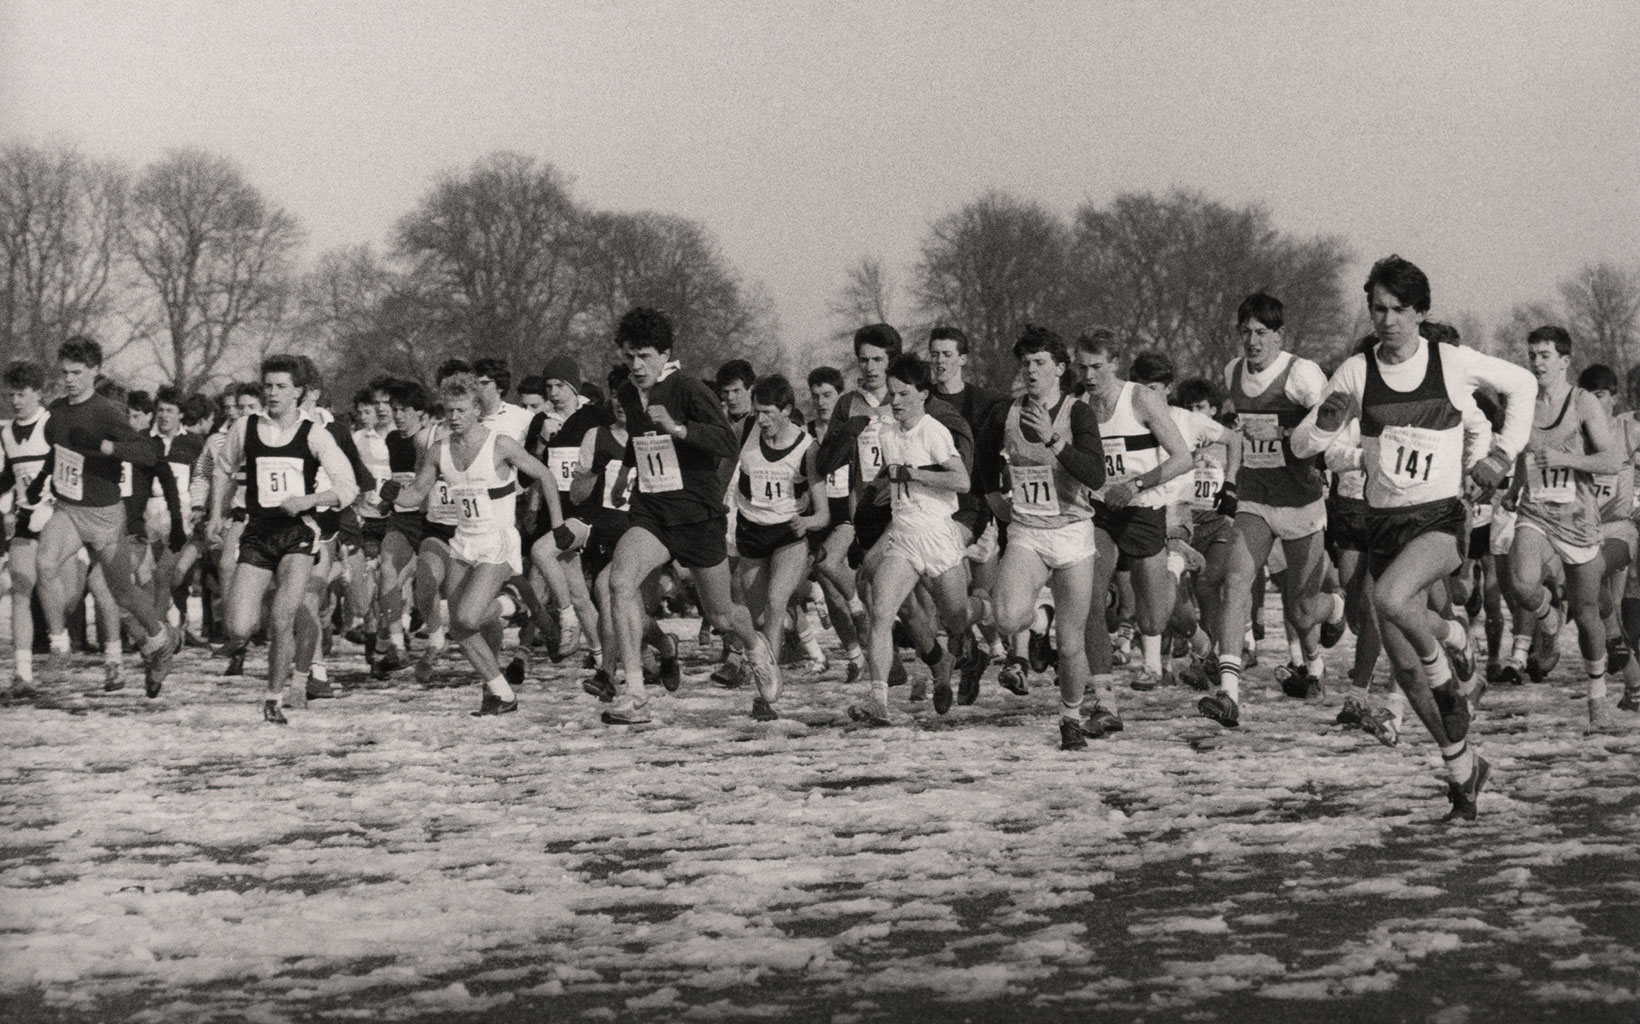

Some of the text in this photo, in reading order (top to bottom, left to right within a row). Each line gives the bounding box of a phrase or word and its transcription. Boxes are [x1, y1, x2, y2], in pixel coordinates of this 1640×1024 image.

[60, 462, 78, 486] 115
[647, 452, 664, 476] 11
[1105, 454, 1125, 476] 34
[1394, 446, 1433, 481] 141
[269, 472, 286, 492] 51
[1541, 467, 1569, 488] 177
[765, 481, 781, 500] 41
[1020, 481, 1050, 503] 171
[462, 498, 479, 518] 31
